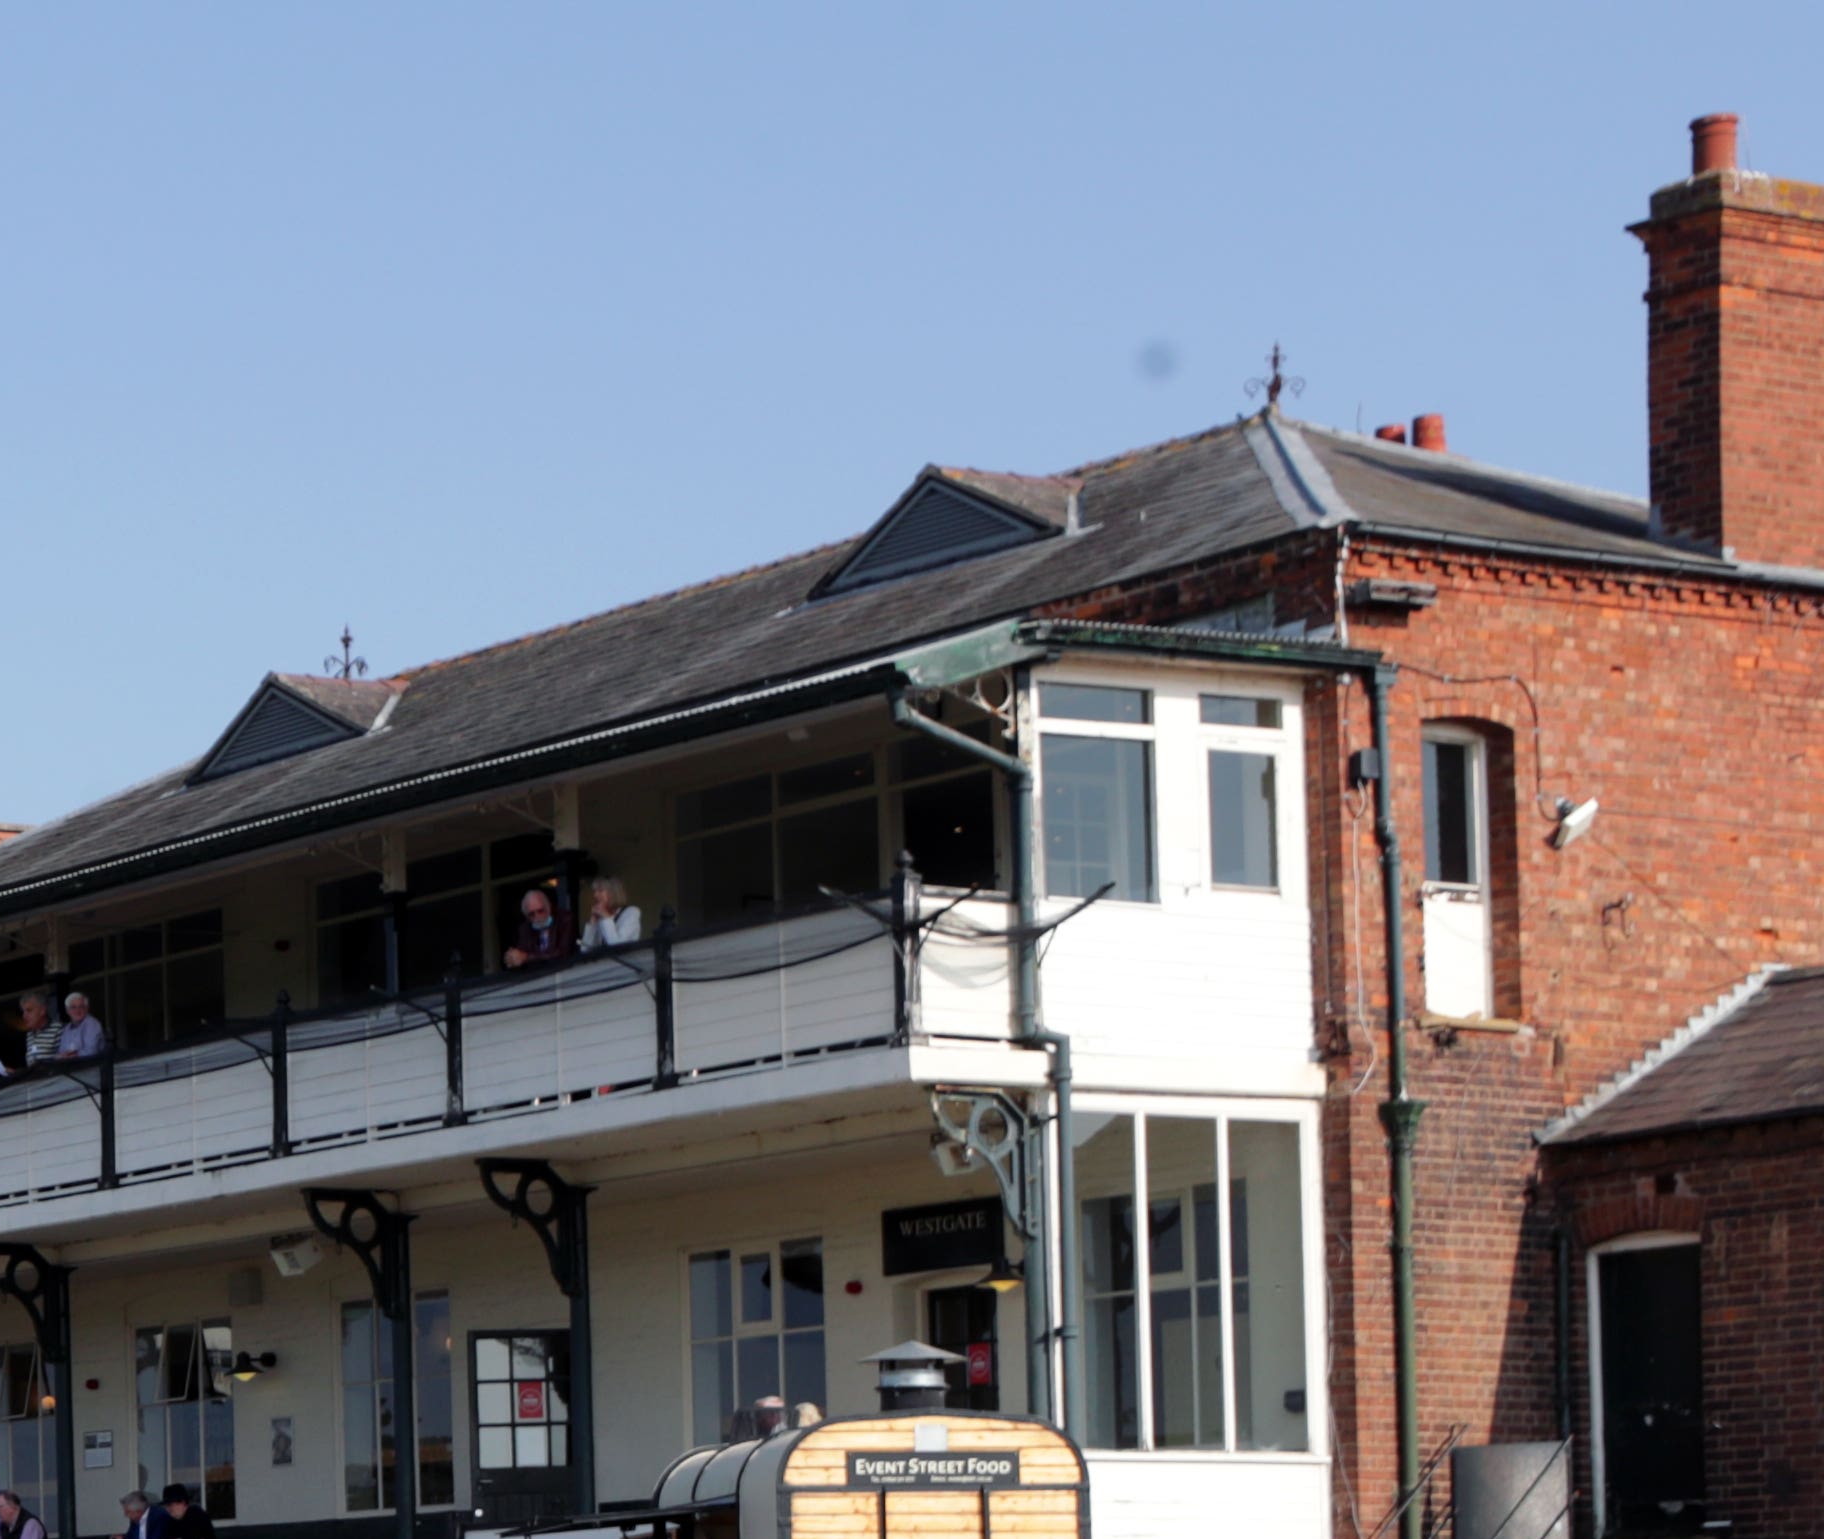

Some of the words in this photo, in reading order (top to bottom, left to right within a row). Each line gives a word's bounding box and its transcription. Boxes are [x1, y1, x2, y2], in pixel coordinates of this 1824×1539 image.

[899, 1211, 986, 1237] WESTGATE
[855, 1458, 907, 1475] EVENT
[908, 1457, 966, 1475] STREET
[967, 1457, 1011, 1474] FOOD
